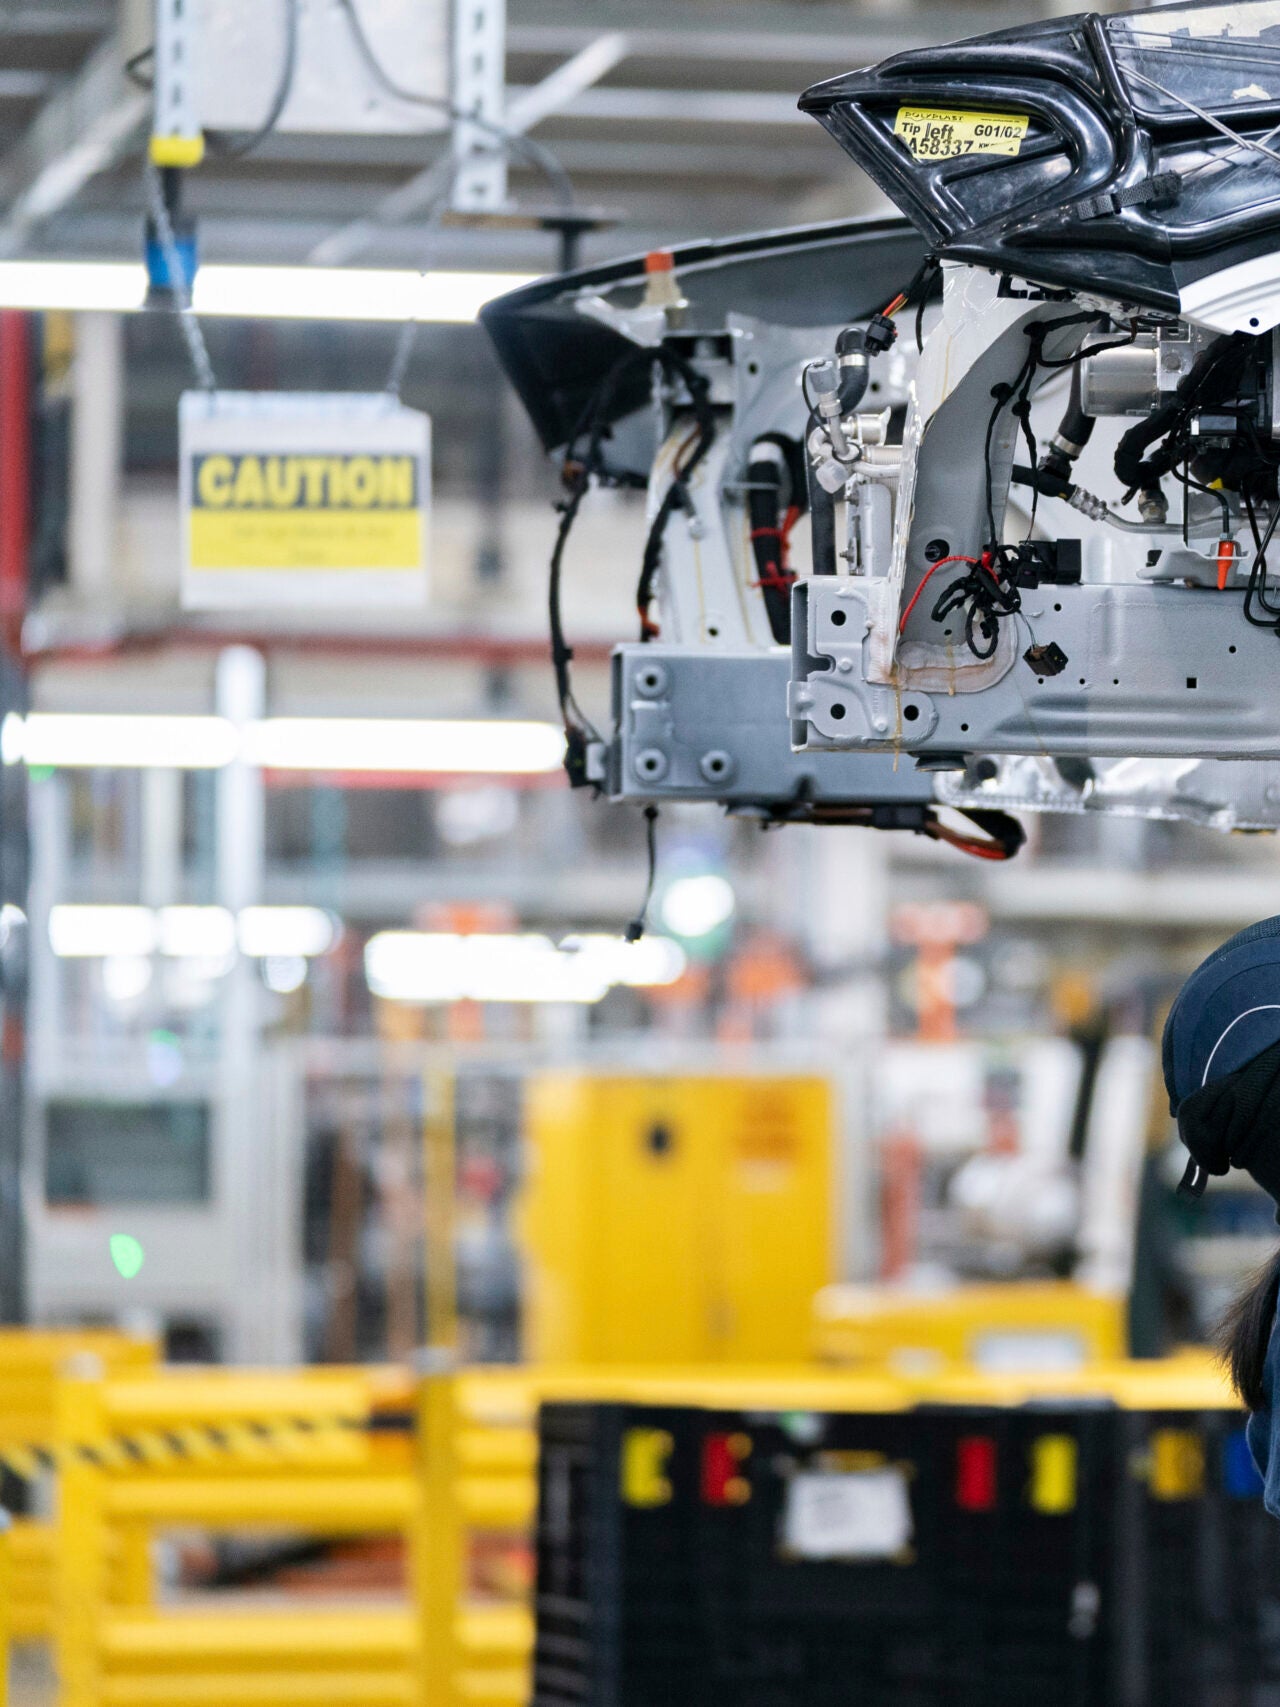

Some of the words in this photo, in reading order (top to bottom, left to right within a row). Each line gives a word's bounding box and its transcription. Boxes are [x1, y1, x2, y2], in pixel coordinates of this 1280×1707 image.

[902, 122, 921, 136] Tip
[925, 122, 954, 140] left
[974, 124, 1022, 138] G01/02
[197, 452, 415, 507] CAUTION
